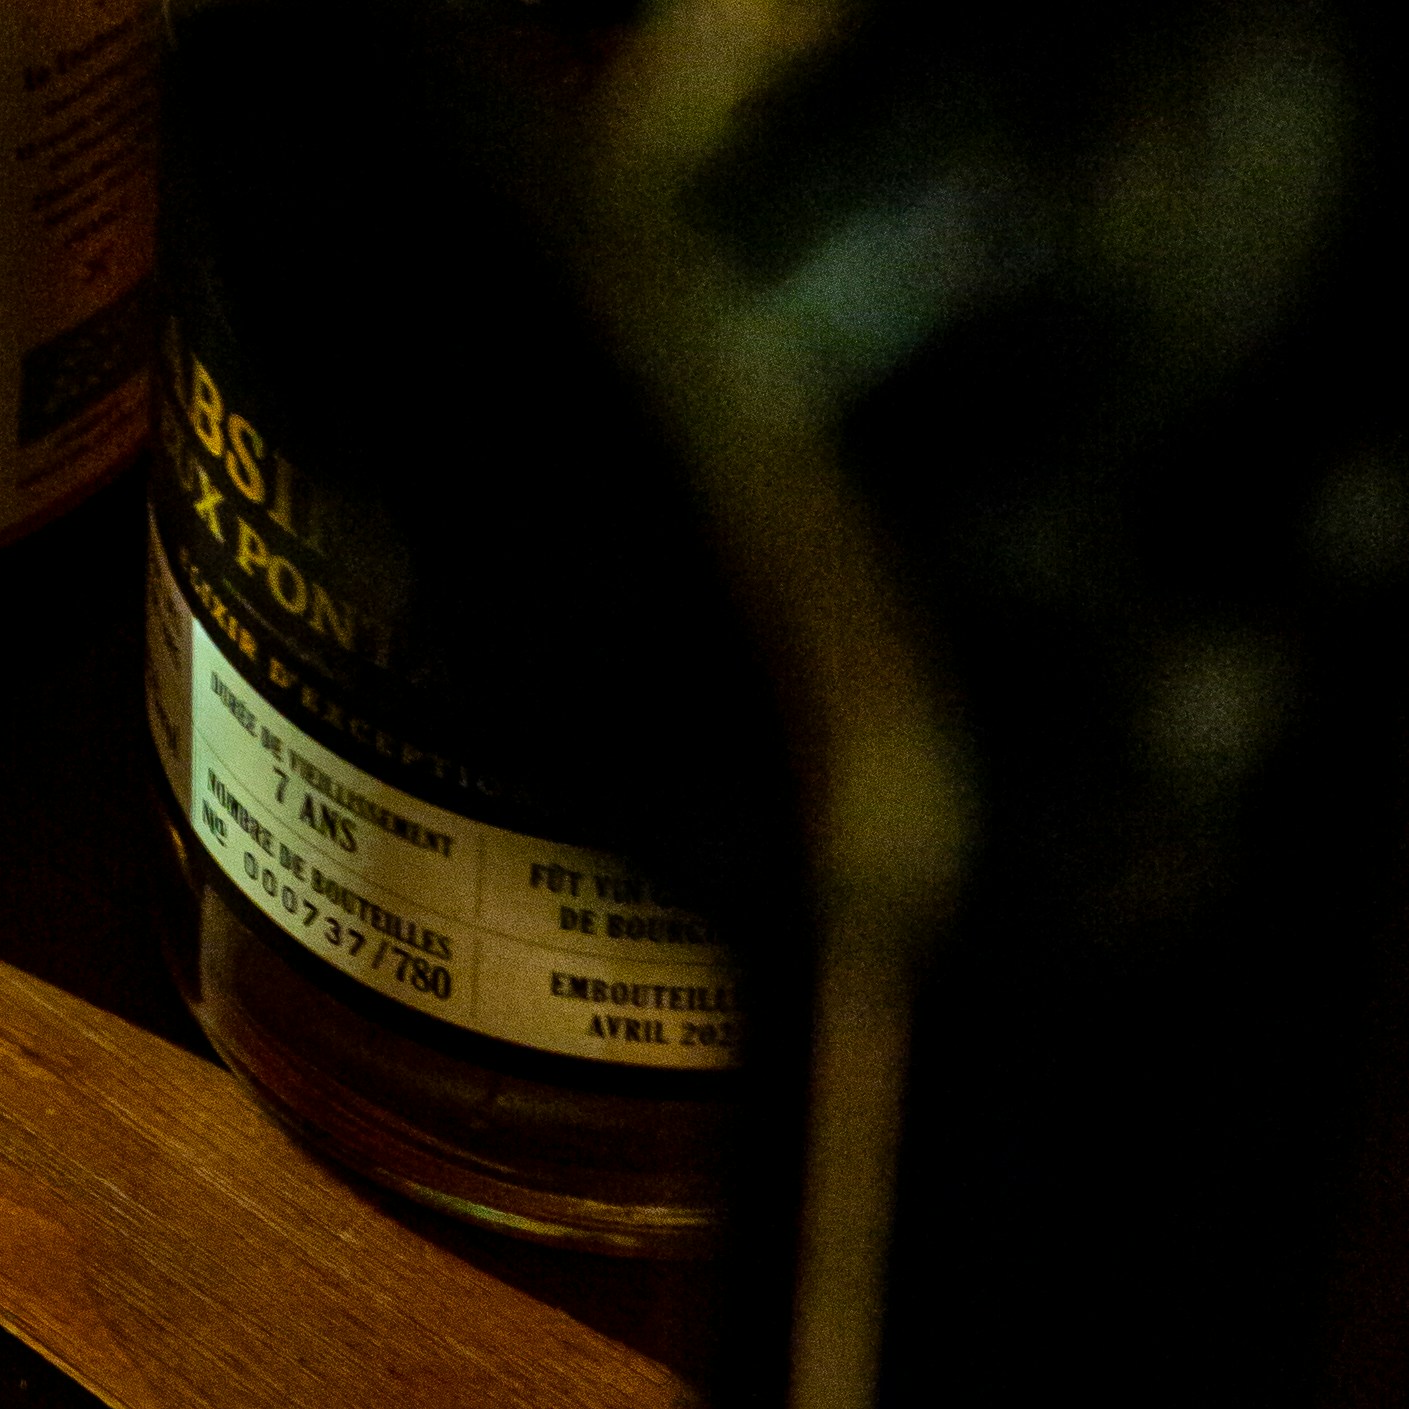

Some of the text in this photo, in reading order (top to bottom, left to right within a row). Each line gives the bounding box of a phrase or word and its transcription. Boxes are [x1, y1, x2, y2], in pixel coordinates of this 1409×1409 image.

[260, 726, 285, 763] DE
[287, 747, 453, 859] VIEILLISSEMENT
[272, 764, 358, 854] 7 ANS
[206, 767, 453, 962] NOMBRE DE BOUTEILLES
[559, 905, 597, 936] DE
[590, 1013, 668, 1045] AVRIL
